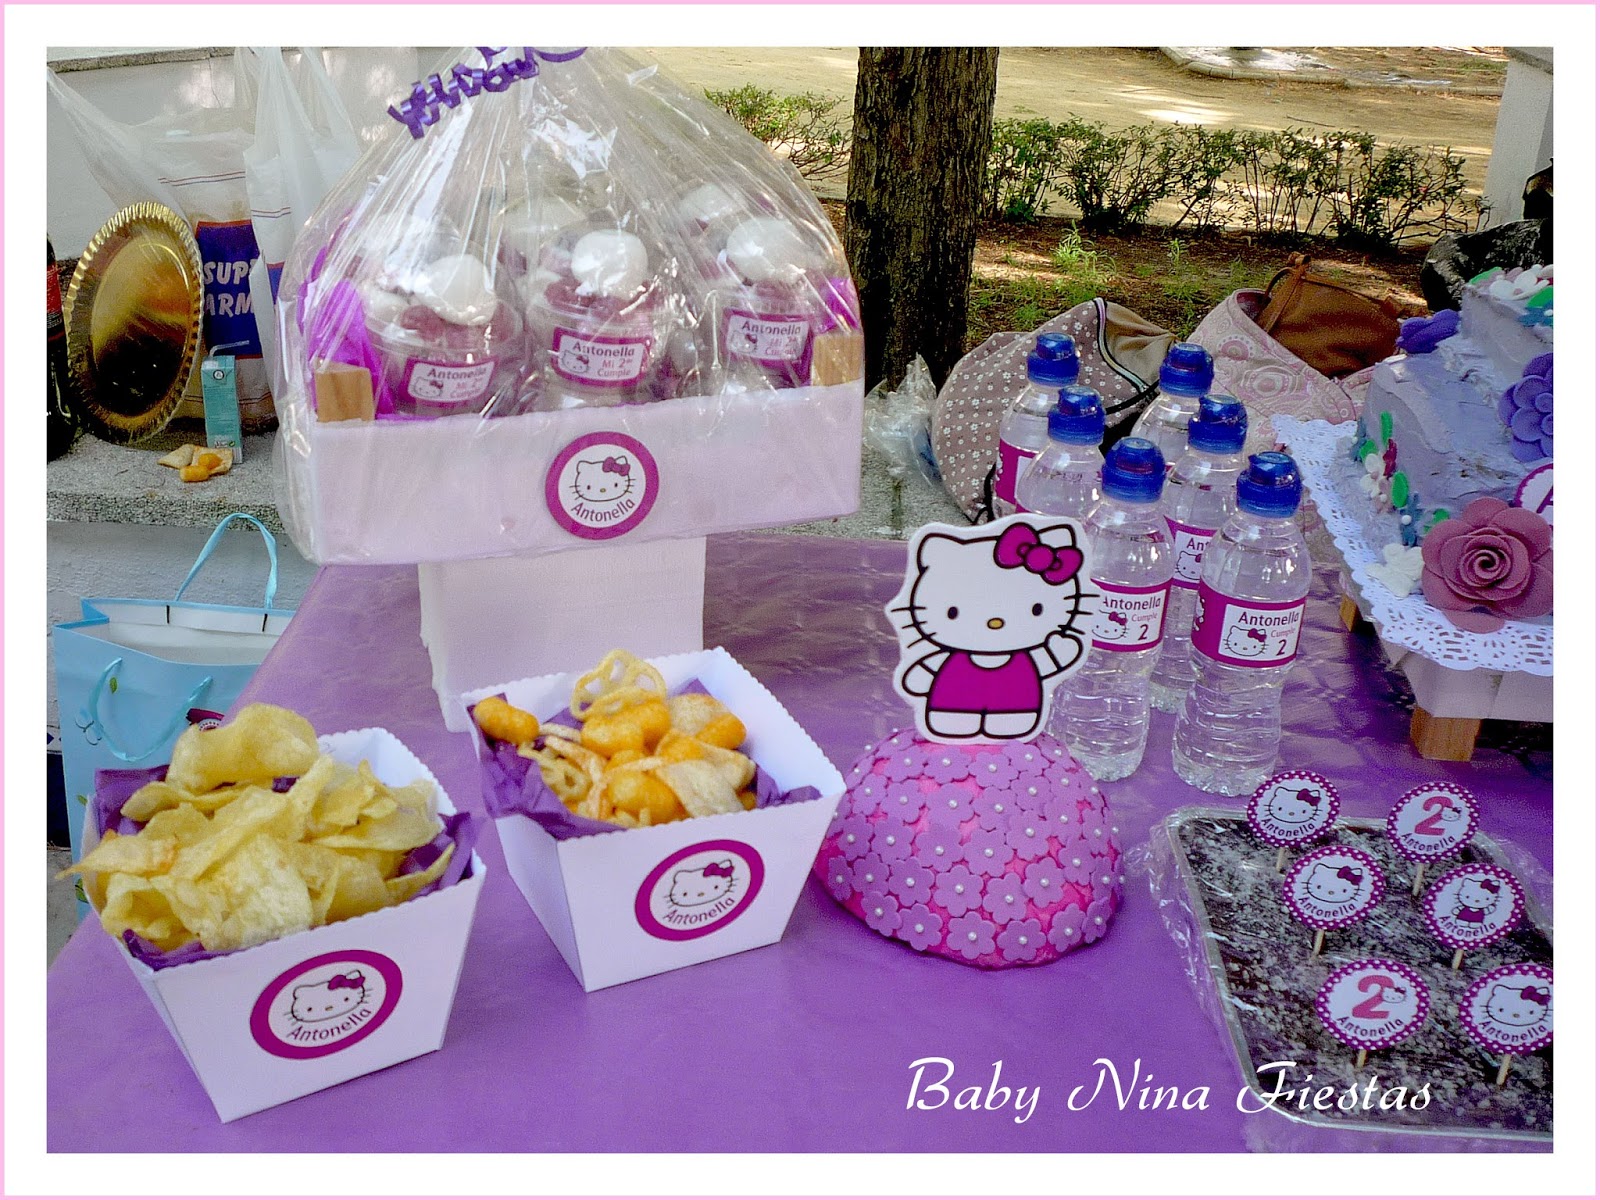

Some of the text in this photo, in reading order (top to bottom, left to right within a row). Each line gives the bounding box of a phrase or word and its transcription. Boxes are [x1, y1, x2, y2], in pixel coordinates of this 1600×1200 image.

[742, 320, 801, 336] Antonella
[573, 341, 635, 357] Antonella
[597, 368, 632, 379] Cumple
[602, 359, 614, 368] Mi
[571, 499, 635, 522] Antonella
[1131, 612, 1158, 623] Cumple
[1238, 611, 1300, 627] Antonella
[1137, 624, 1149, 641] 2
[1270, 627, 1297, 639] Cumple
[1276, 639, 1287, 656] 2
[1414, 795, 1454, 836] 2
[1261, 817, 1316, 838] Antonella
[1401, 832, 1456, 852] Antonella
[663, 895, 735, 927] Antonella
[1298, 896, 1356, 918] Antonella
[1439, 915, 1497, 938] Antonella
[1352, 974, 1395, 1019] 2
[285, 1005, 373, 1043] Antonella
[1336, 1015, 1404, 1038] Antonella
[1478, 1020, 1548, 1043] Antonella
